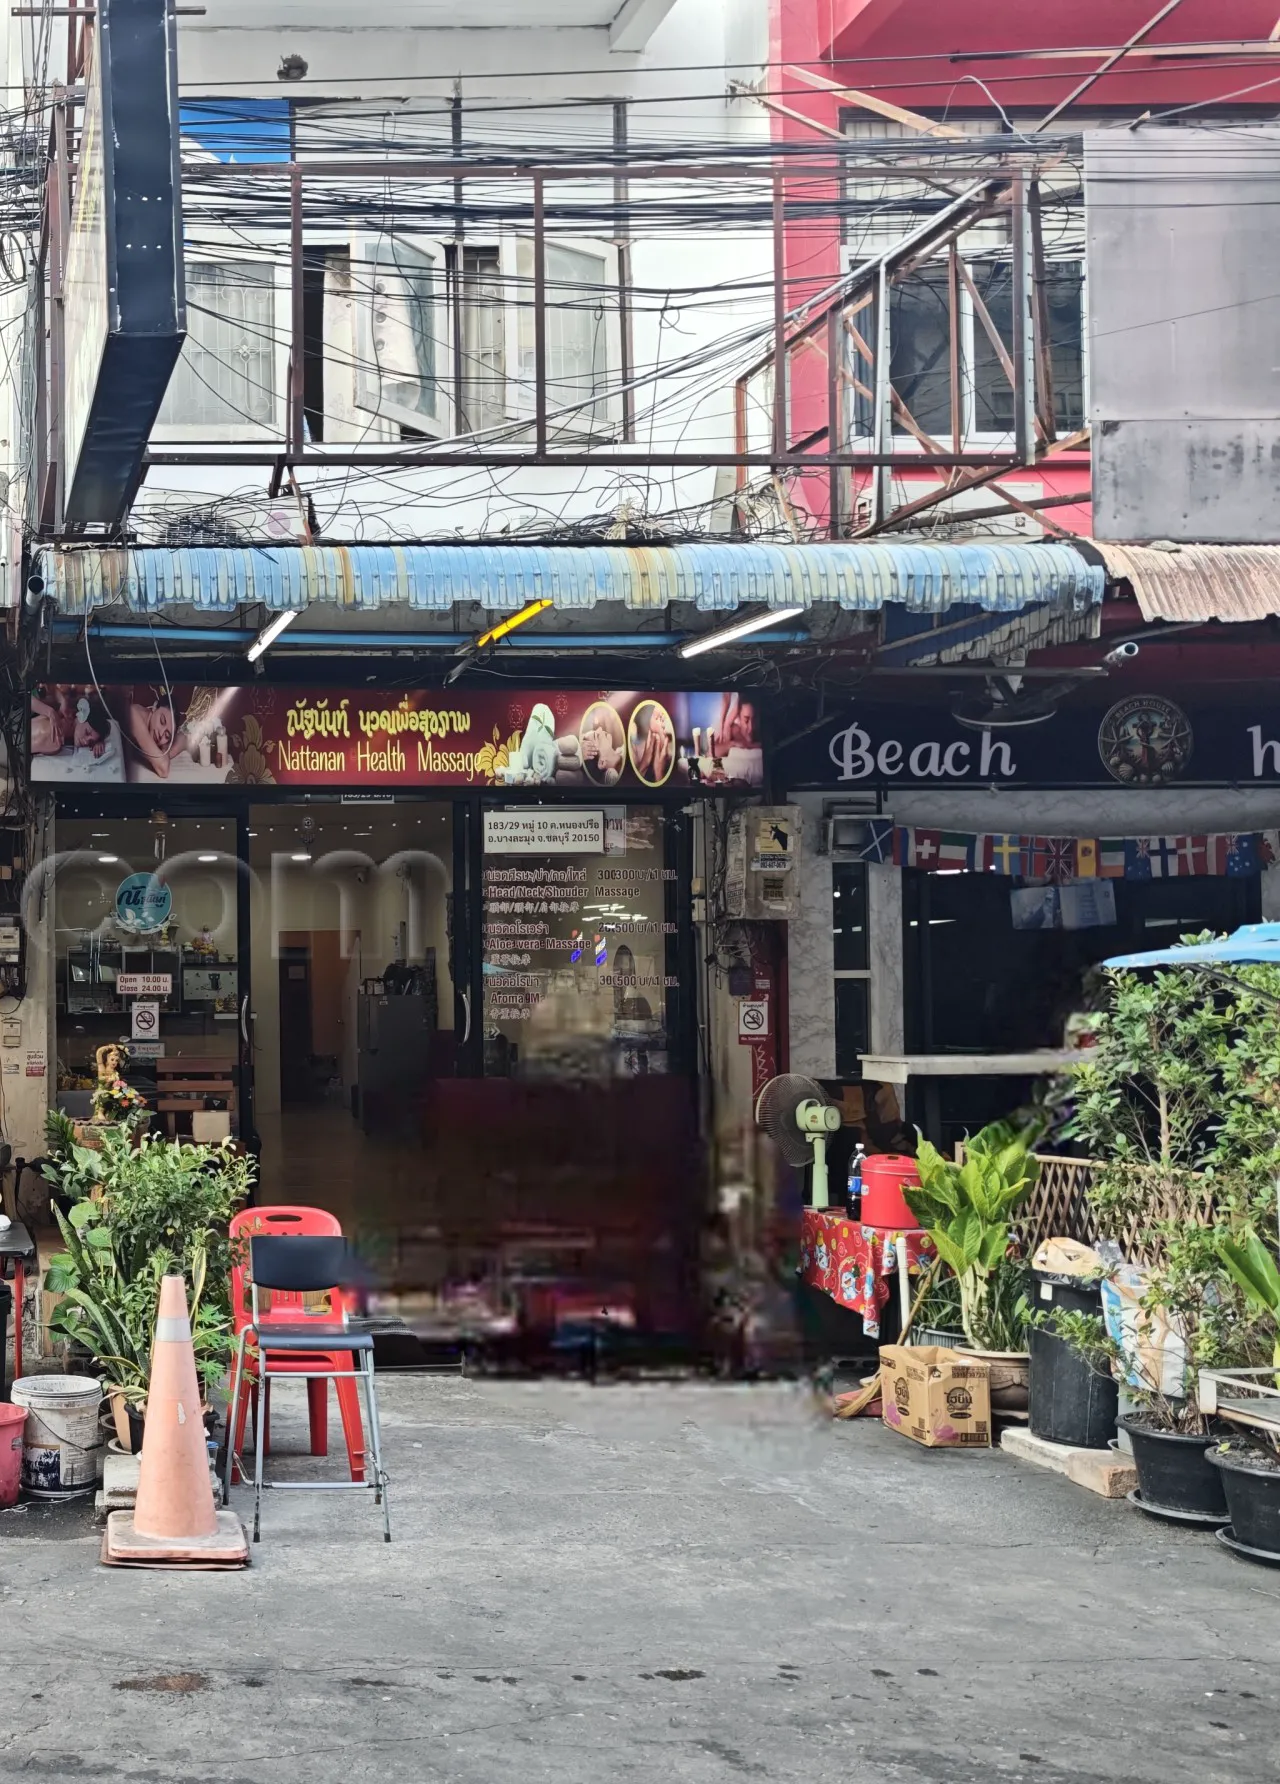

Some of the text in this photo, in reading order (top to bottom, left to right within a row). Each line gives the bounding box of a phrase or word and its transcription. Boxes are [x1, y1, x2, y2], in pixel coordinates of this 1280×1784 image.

[358, 693, 471, 741] นวดเพื่อสุขภาพ
[829, 721, 1017, 781] Beach
[278, 739, 483, 782] Nattanan Health Massage
[488, 821, 520, 830] 183/29
[537, 821, 548, 830] 10
[571, 833, 600, 842] 20150
[595, 886, 640, 900] Massage
[546, 937, 591, 951] Massage
[120, 975, 137, 984] Open
[141, 975, 161, 983] 10.00
